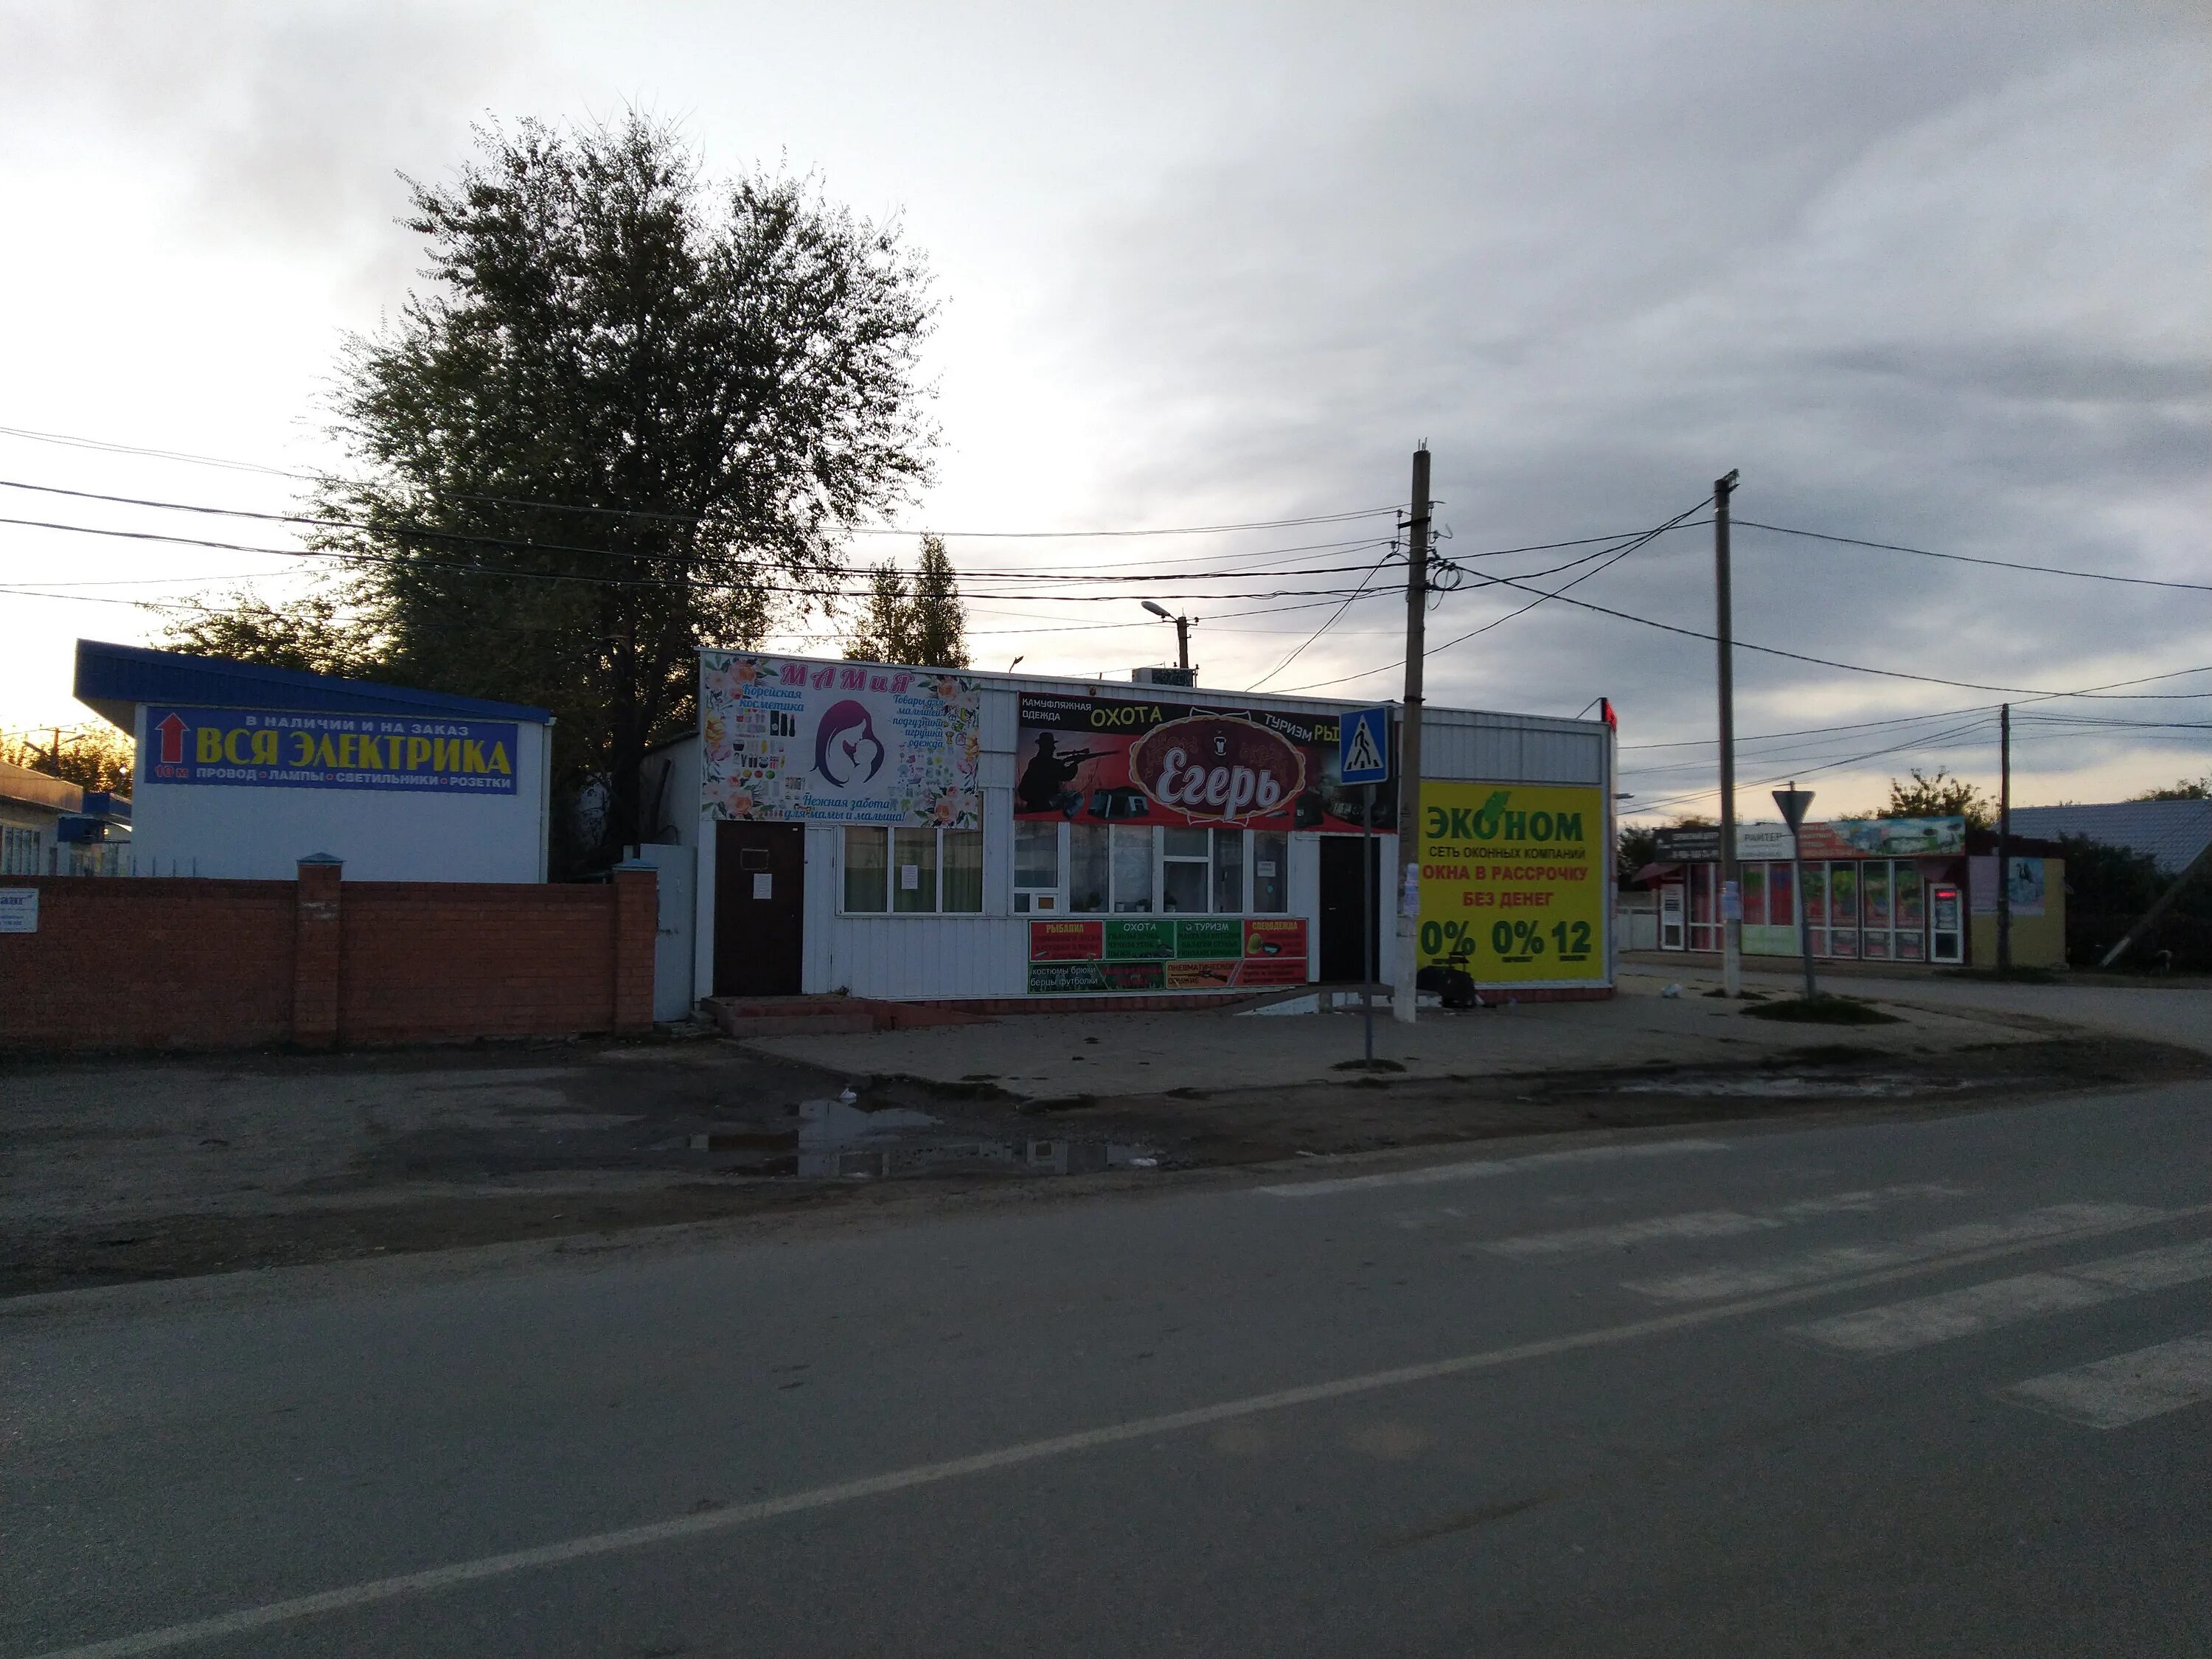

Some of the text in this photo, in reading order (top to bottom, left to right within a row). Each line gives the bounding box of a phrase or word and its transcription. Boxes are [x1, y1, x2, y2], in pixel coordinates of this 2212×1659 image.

[742, 684, 802, 699] Корейская
[739, 699, 805, 712] косметика
[893, 695, 925, 707] Товары
[1021, 698, 1092, 712] КАМУФЛЯЖНАЯ
[1022, 710, 1061, 722] ОДЕЖДА
[1090, 705, 1163, 728] ОХОТА
[245, 716, 470, 737] В НАЛИЧИИ И НА ЗАКАЗ
[1264, 712, 1312, 742] ТУРИЗМ
[195, 726, 512, 776] ВСЯ ЭЛЕКТРИКА
[908, 740, 944, 750] одежда
[195, 767, 511, 788] ПРОВОД ЛАМПЫ СВЕТИЛЬНИКИ РОЗЕТКИ
[1155, 747, 1281, 821] Егерь
[802, 793, 848, 808] Нежная
[784, 810, 906, 821] для мамы и малыша!
[1426, 805, 1584, 842] ЭКОНОМ
[1429, 846, 1586, 860] СЕТЬ ОКОННЫХ КОМПАНИЙ
[1422, 864, 1588, 882] ОКНА В РАССРОЧКУ
[1462, 891, 1554, 908] БЕЗ ДЕНЕГ
[1123, 922, 1158, 932] ОХОТА
[1194, 922, 1230, 932] ТУРИЗМ
[1421, 919, 1592, 956] 0% 0% 12
[1032, 967, 1069, 975] костюмы
[1071, 966, 1097, 976] брюки
[1030, 977, 1098, 987] берцы футболки
